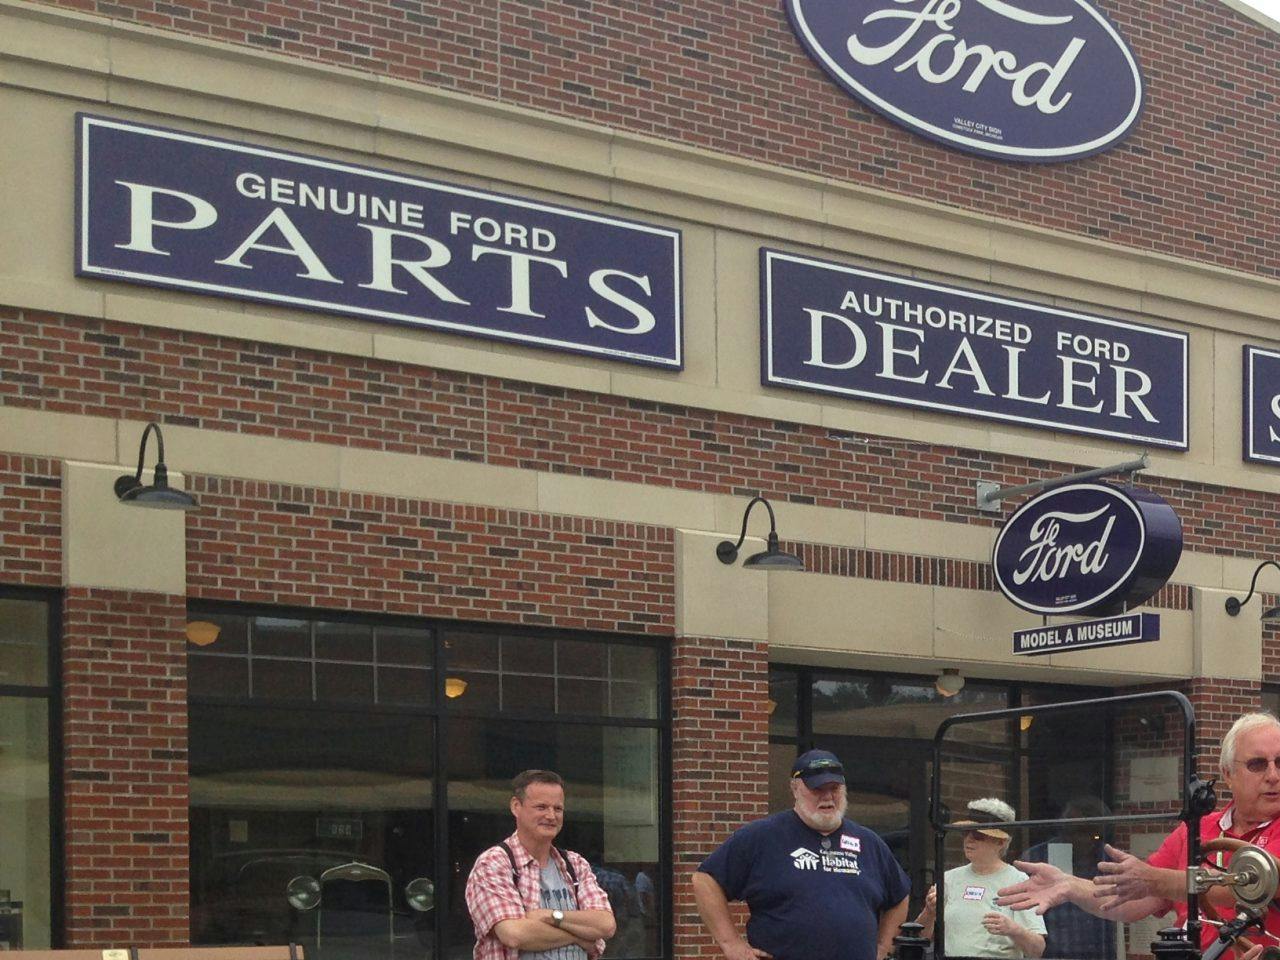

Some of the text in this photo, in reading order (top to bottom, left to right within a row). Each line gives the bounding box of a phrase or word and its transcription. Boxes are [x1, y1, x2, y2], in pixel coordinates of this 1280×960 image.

[847, 0, 1086, 114] Ford
[954, 116, 974, 127] VALLEY
[975, 122, 988, 130] CITY
[236, 173, 556, 252] GENUINE FORD
[115, 181, 656, 335] PARTS
[803, 308, 1160, 424] DEALER
[841, 291, 1130, 362] AUTHORIZED FORD
[1013, 503, 1117, 585] Ford
[1020, 620, 1133, 649] MODEL A MUSEUM
[821, 856, 860, 869] Habitat
